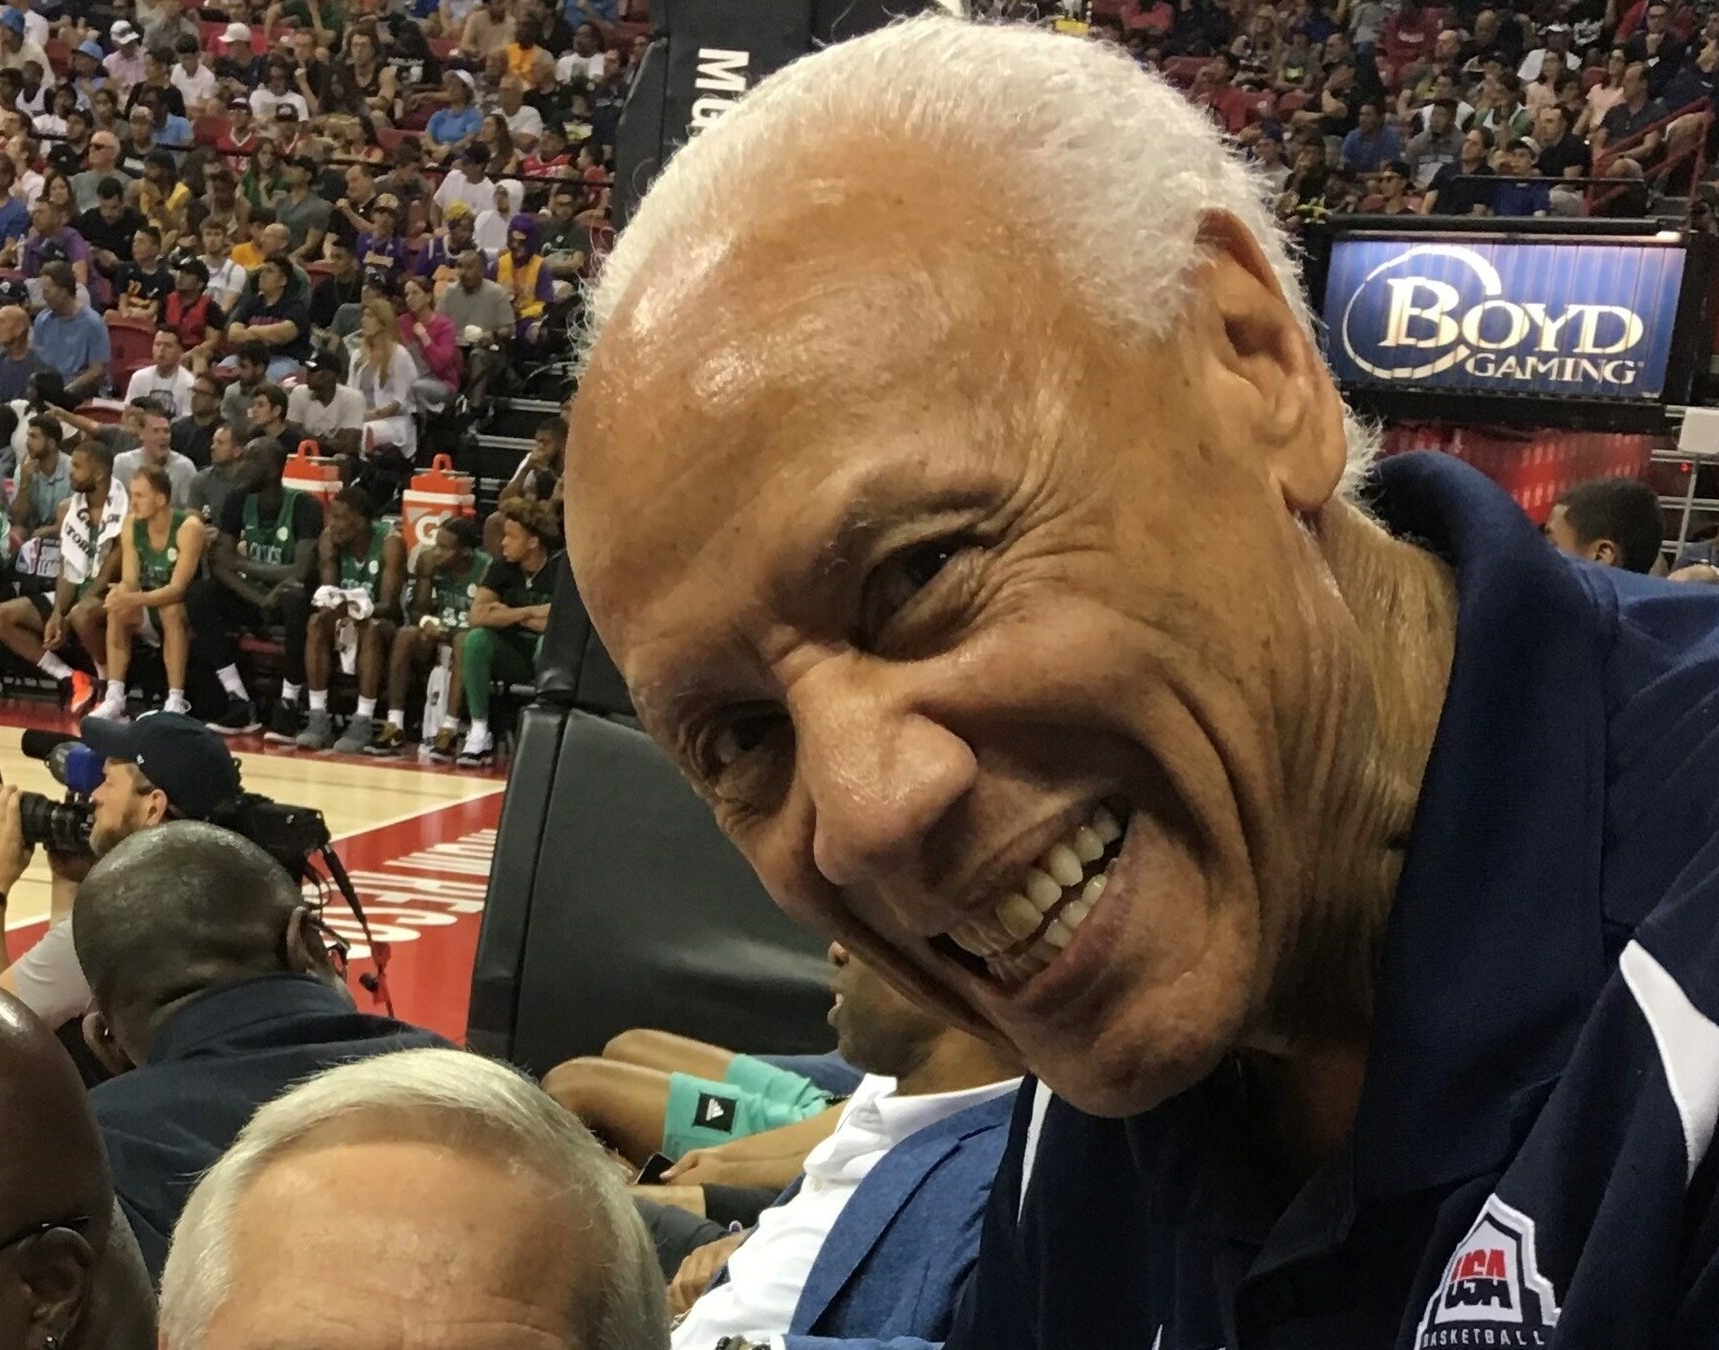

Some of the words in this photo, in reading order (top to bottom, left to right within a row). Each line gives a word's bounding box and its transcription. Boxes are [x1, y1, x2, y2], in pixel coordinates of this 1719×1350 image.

[1378, 277, 1644, 354] BOYD
[1465, 353, 1637, 384] GAMING
[1444, 1248, 1513, 1310] USA
[1422, 1327, 1545, 1348] BASKETBALL
